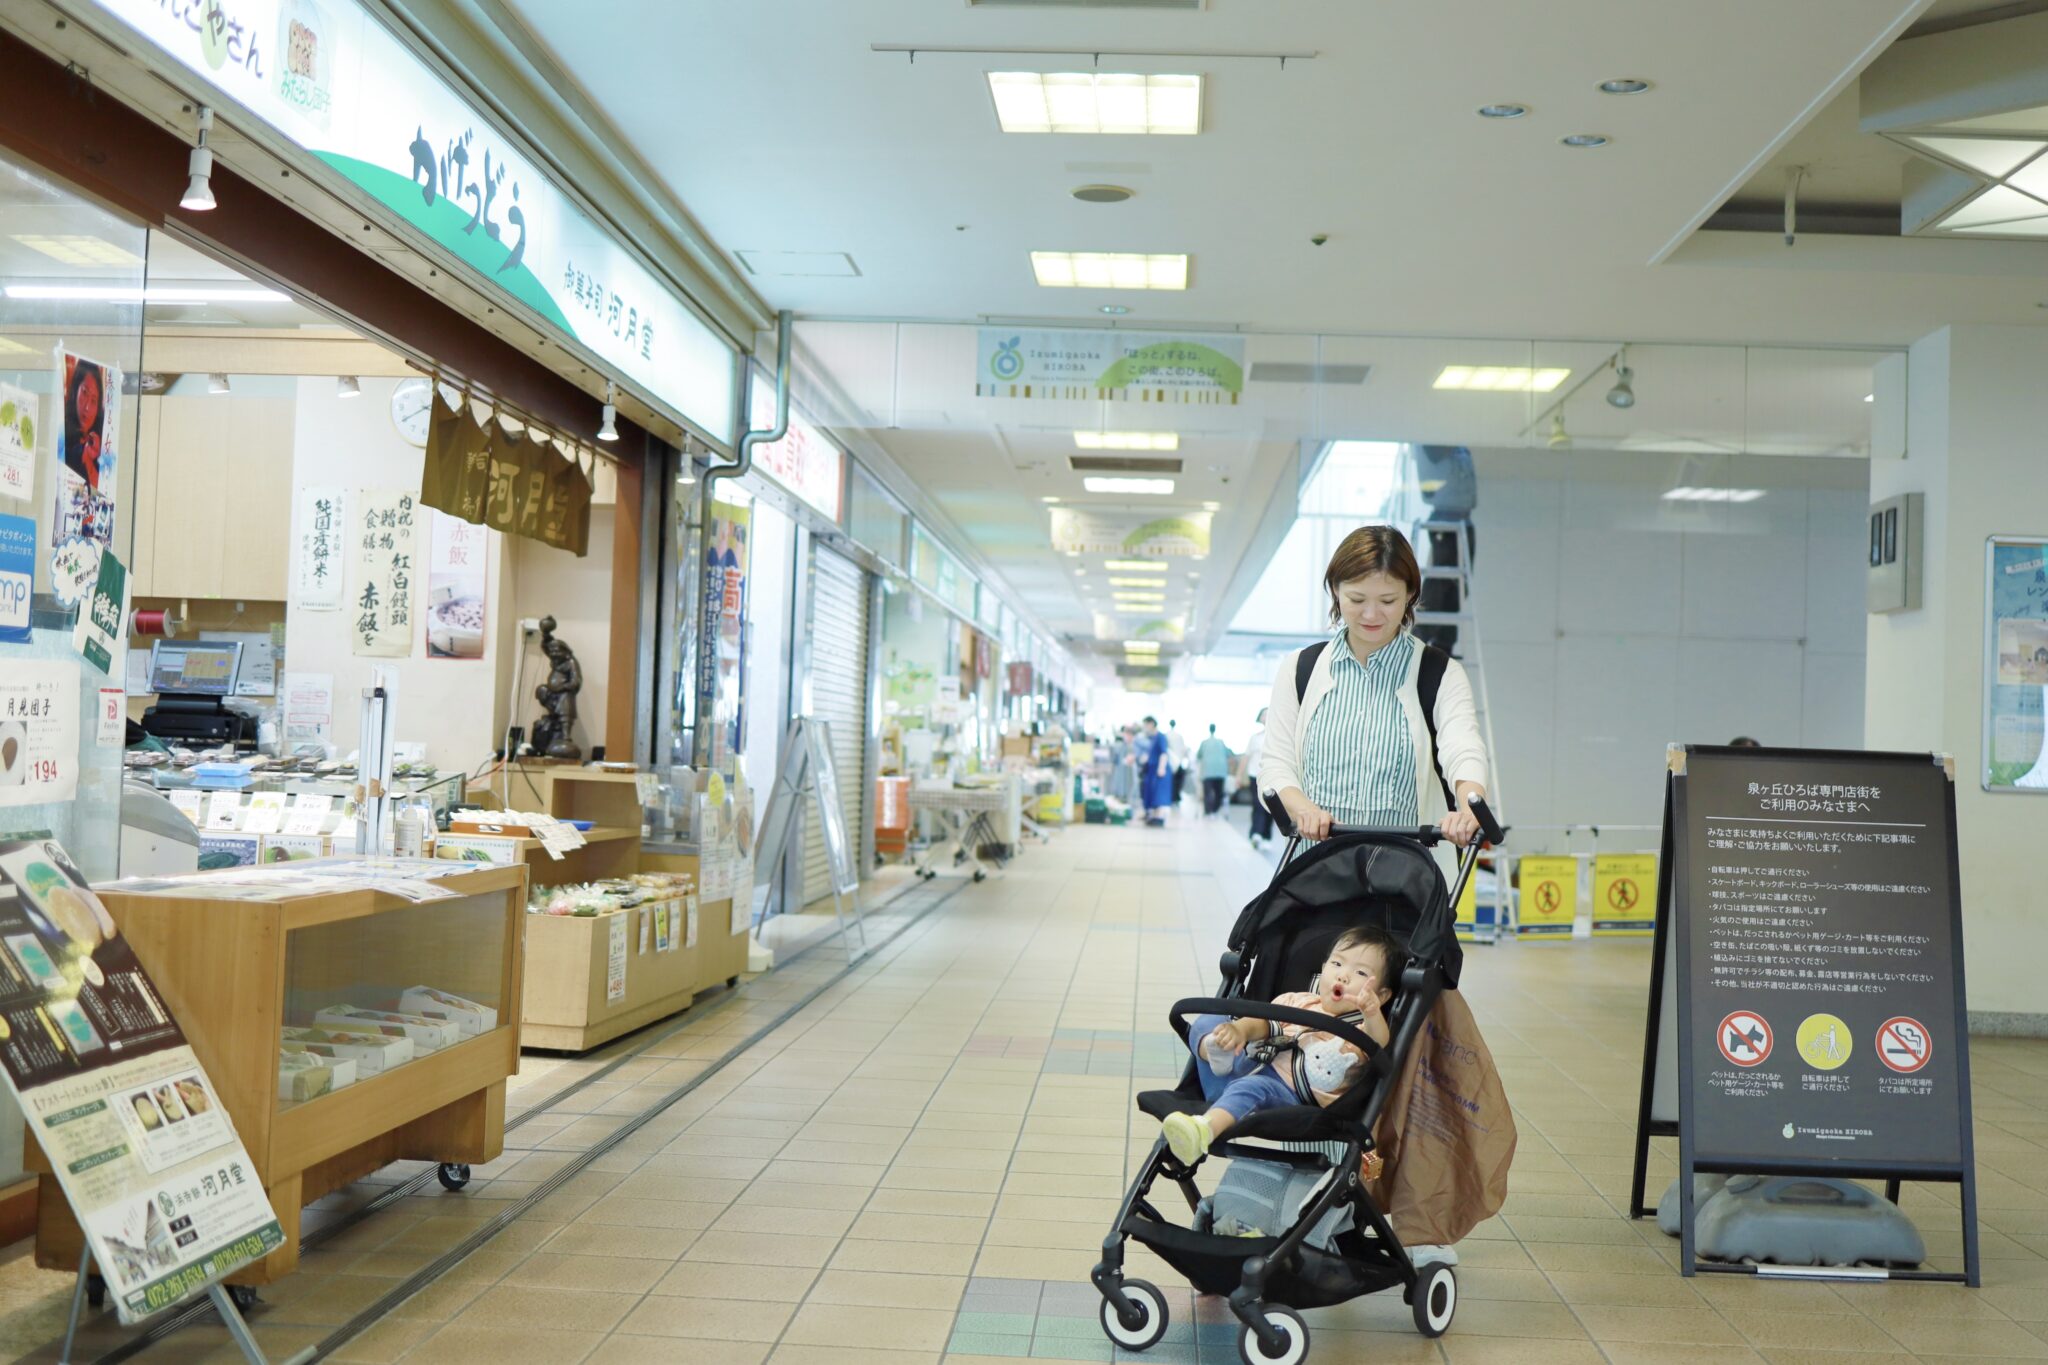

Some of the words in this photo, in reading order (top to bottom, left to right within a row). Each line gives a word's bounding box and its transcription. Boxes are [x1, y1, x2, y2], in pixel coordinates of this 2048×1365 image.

[608, 291, 654, 361] 河月堂
[1030, 349, 1101, 361] Izumigaoka
[1043, 363, 1087, 372] HIROBA
[398, 496, 413, 539] 内祝の
[449, 521, 469, 565] 赤飯
[390, 552, 411, 626] 紅白饅頭
[356, 580, 380, 647] 赤飯を
[7, 697, 51, 717] 月見団子
[34, 759, 58, 780] 194
[1747, 782, 1881, 799] 泉ヶ丘ひろば専門店街を
[1760, 798, 1871, 813] ご利用のみなさまへ
[1707, 827, 1916, 844] みなさまに気持ちよくご利用いただくために下記事項に
[1707, 839, 1842, 853] ご理解・ご協力をお願いいたします。
[1801, 1074, 1850, 1083] 自転車は押して
[1802, 1082, 1850, 1092] ご通行ください
[1724, 1088, 1769, 1097] ご利用ください
[1879, 1086, 1933, 1096] にてお願いします
[201, 1162, 246, 1197] 河月堂
